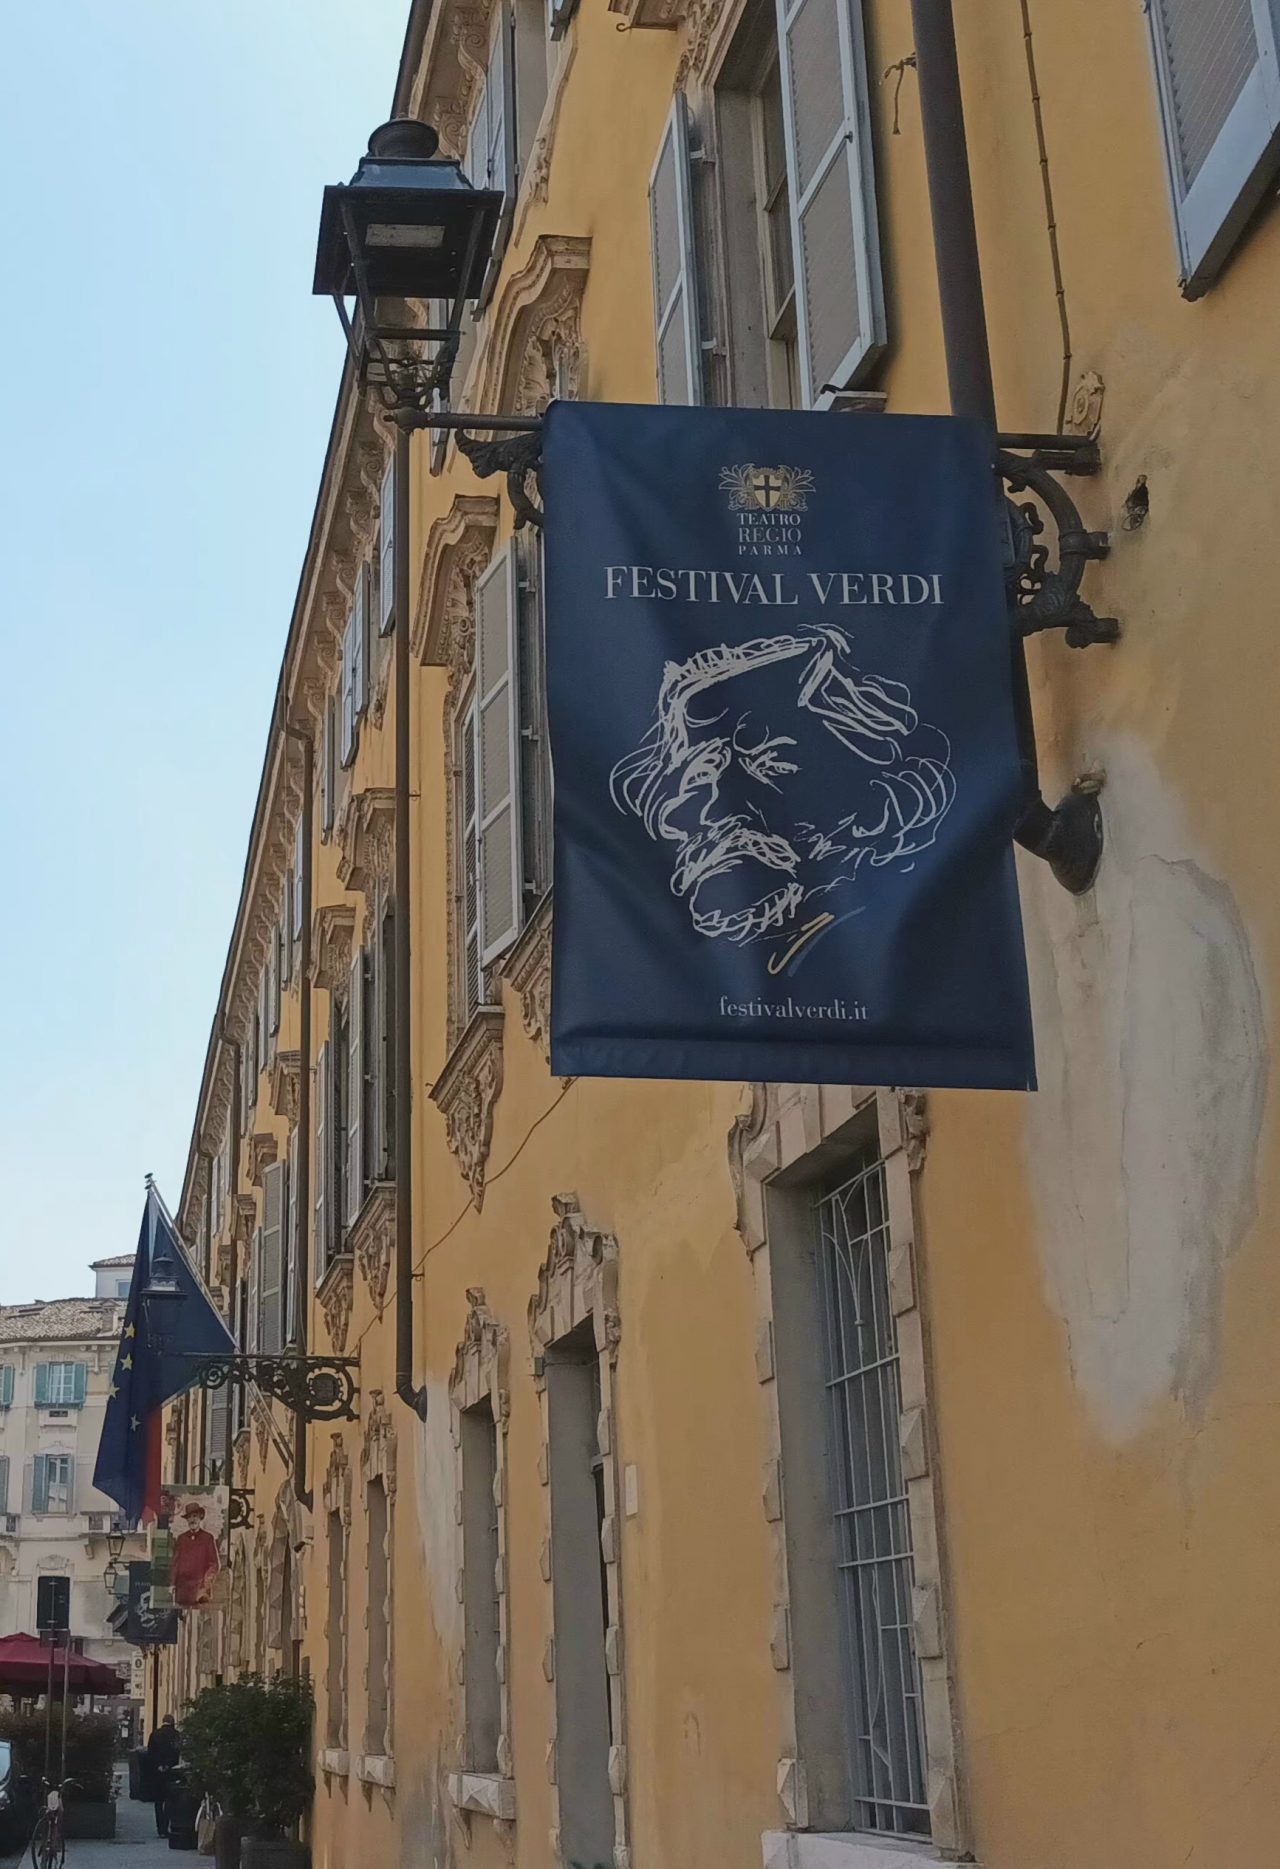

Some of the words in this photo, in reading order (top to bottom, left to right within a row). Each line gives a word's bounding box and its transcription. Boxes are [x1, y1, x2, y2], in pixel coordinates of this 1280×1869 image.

[737, 513, 801, 526] TEATRO
[738, 527, 802, 543] REGIO
[738, 544, 802, 556] PARMA
[604, 565, 799, 606] FESTIVAL
[806, 572, 945, 606] VERDI
[719, 995, 869, 1020] festivalverdi.it
